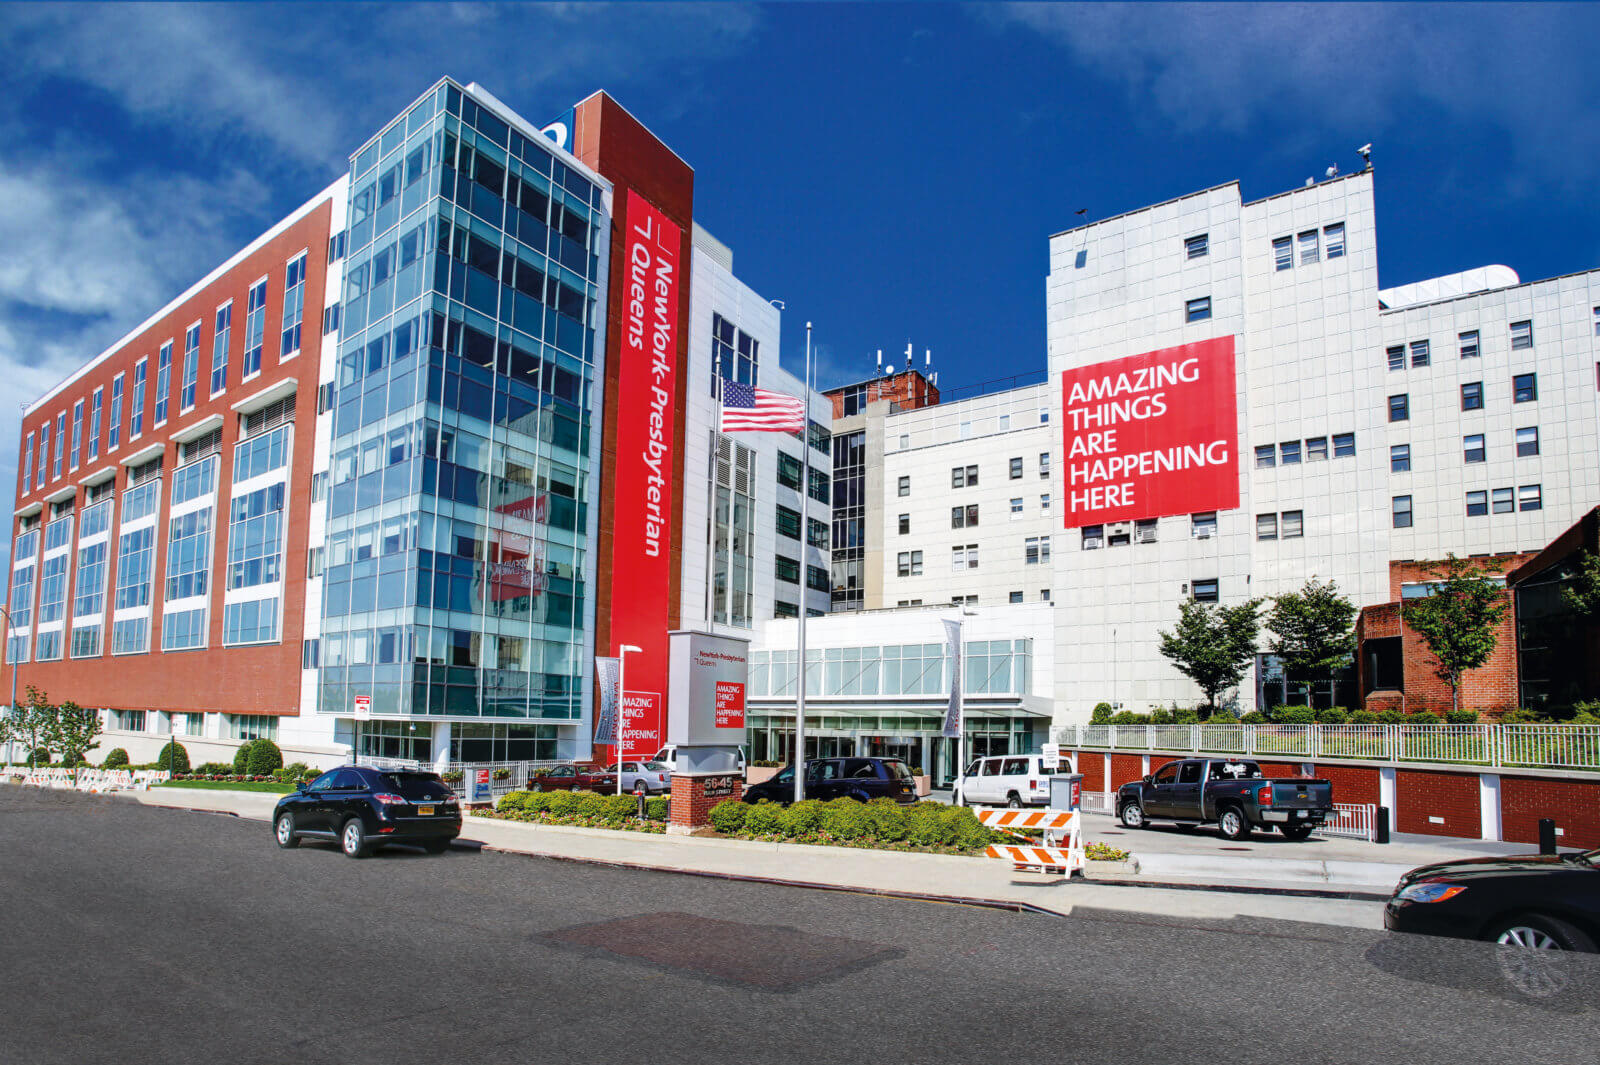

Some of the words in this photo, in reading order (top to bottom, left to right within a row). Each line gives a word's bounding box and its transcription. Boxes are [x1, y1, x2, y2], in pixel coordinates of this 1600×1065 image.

[628, 242, 651, 350] Queens
[1068, 358, 1200, 405] AMAZING
[643, 257, 674, 557] NewYork-Presbyterian
[1068, 393, 1167, 431] THINGS
[1069, 429, 1117, 459] ARE
[1070, 440, 1228, 486] HAPPENING
[1070, 482, 1135, 513] HERE
[716, 685, 740, 694] AMAZING
[716, 693, 735, 701] THINGS
[620, 708, 645, 718] HINGS
[716, 701, 726, 709] ARE
[716, 709, 744, 717] HAPPENING
[716, 717, 729, 725] HERE
[704, 777, 733, 789] 56-45
